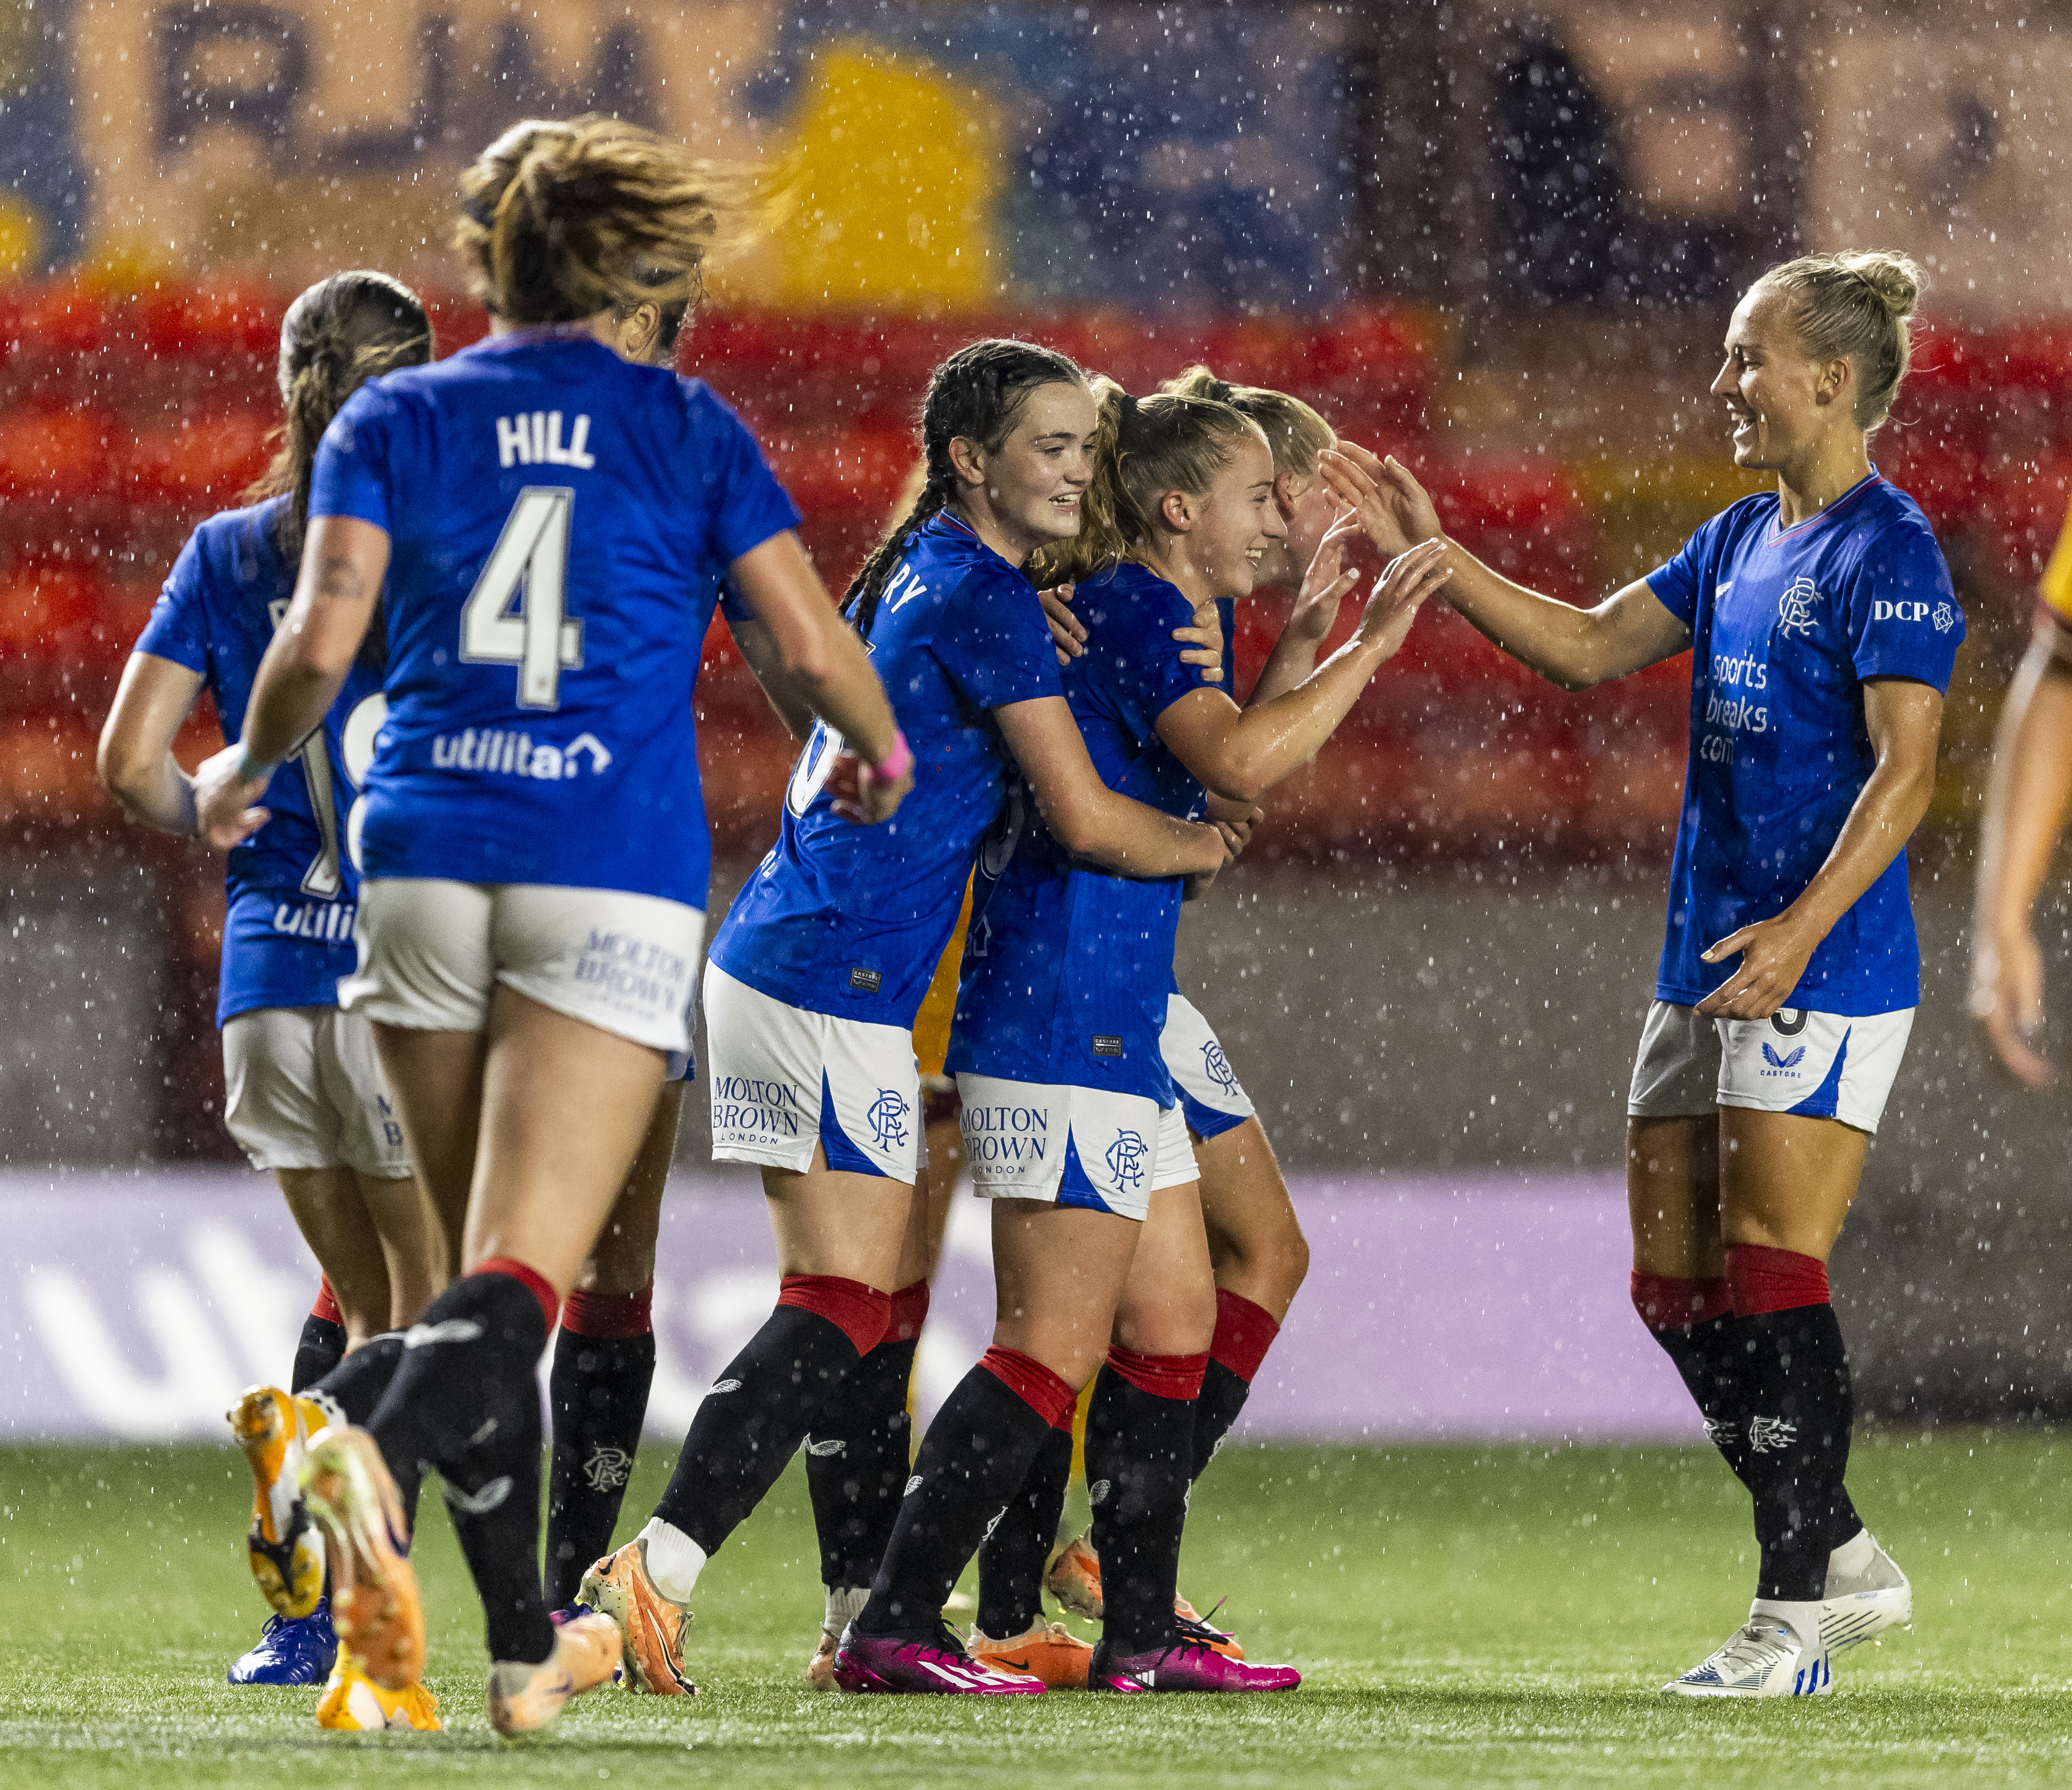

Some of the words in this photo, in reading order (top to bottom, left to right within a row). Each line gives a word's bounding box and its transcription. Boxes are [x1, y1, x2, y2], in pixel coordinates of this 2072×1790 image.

[495, 410, 596, 470] HILL
[458, 485, 584, 712] 4
[1874, 601, 1929, 622] DCP
[1714, 653, 1766, 689] sports
[1706, 688, 1767, 732] breaks
[1700, 734, 1734, 765] com
[1760, 1069, 1801, 1078] CASTORE
[714, 1076, 798, 1108] MOLTON
[713, 1105, 798, 1136] BROWN
[961, 1107, 1048, 1132] MOLTON
[721, 1132, 778, 1145] LONDON
[965, 1136, 1046, 1161] BROWN
